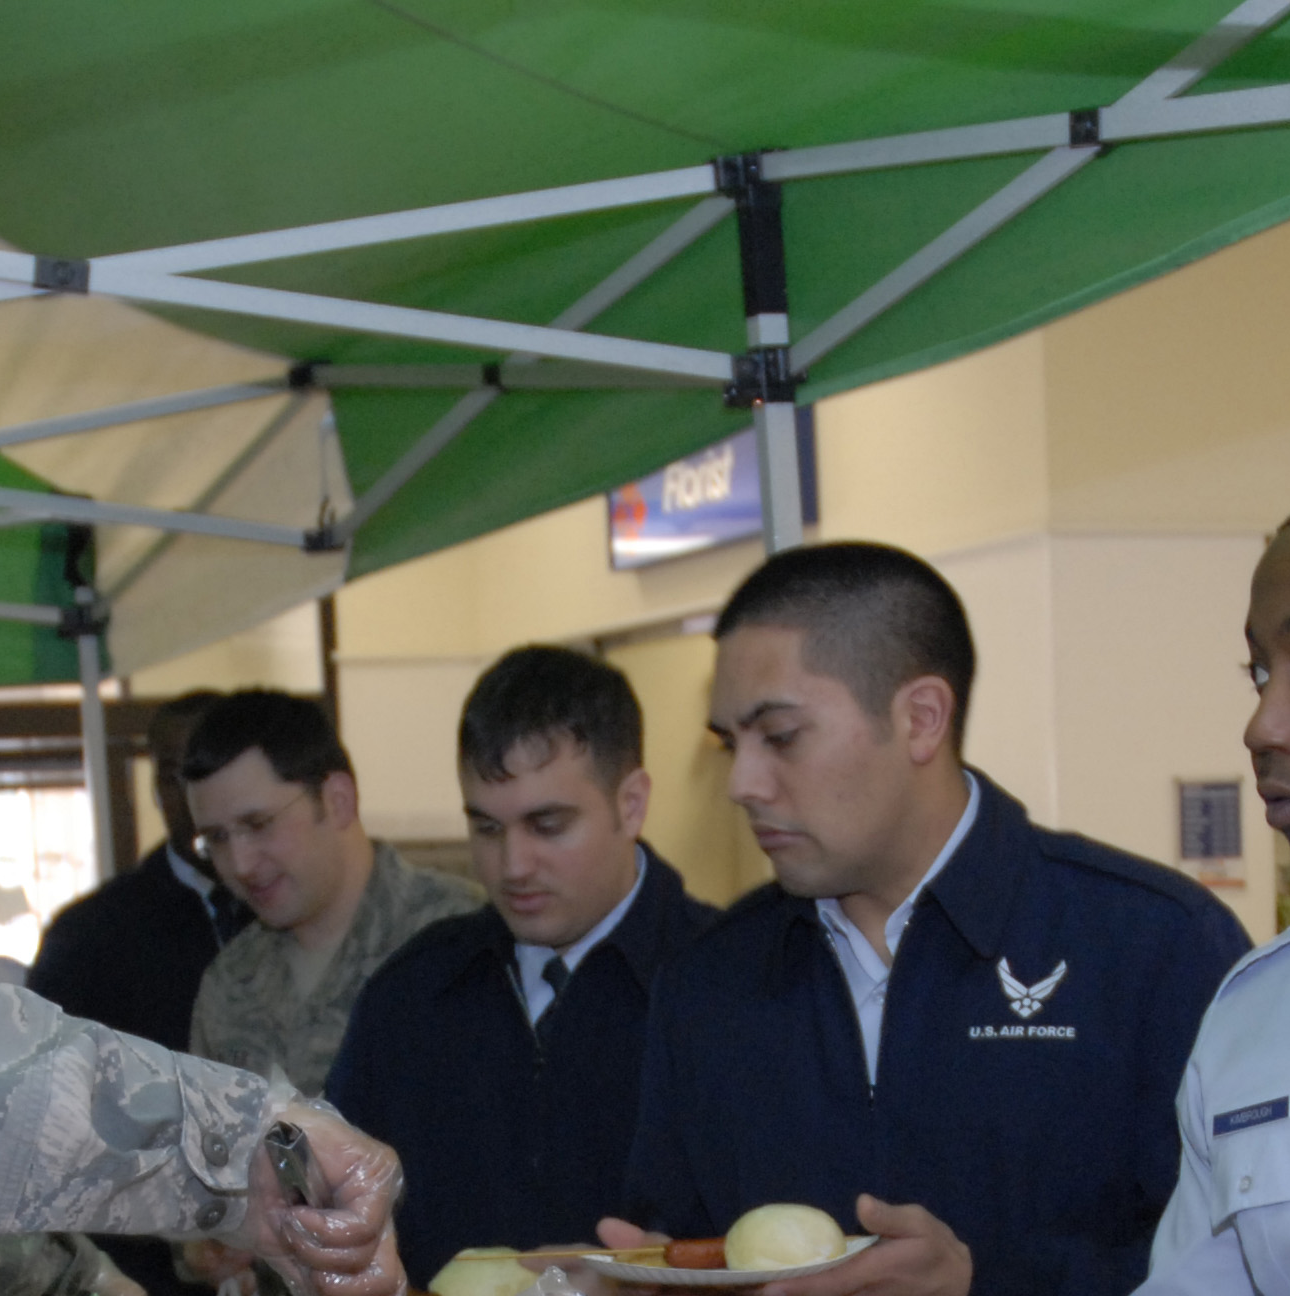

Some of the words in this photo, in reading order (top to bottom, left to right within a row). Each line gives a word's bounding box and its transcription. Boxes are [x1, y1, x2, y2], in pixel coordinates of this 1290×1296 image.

[969, 1025, 998, 1039] U.S.
[999, 1025, 1025, 1038] AIR
[1027, 1025, 1076, 1039] FORCE
